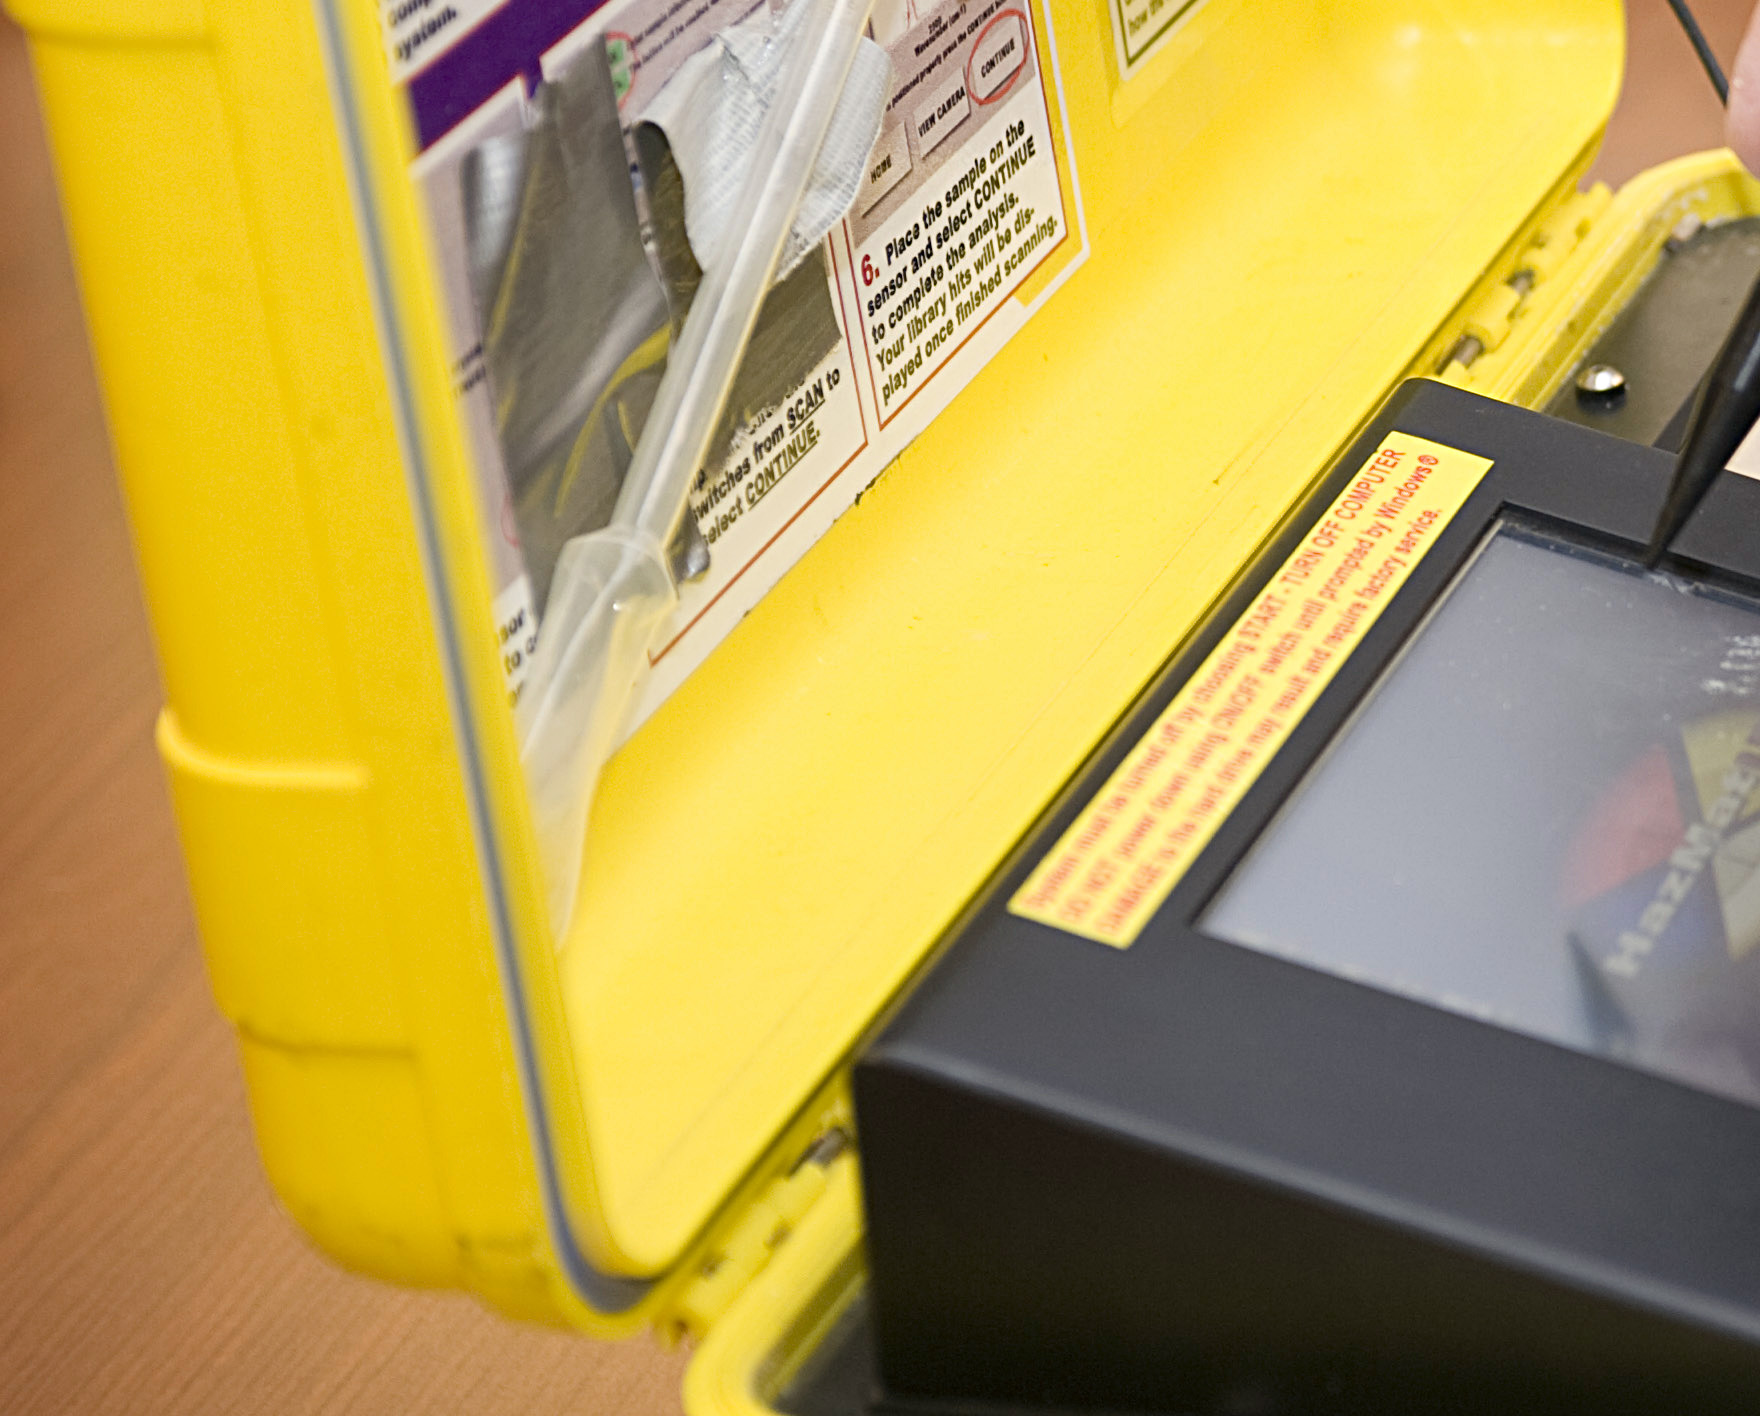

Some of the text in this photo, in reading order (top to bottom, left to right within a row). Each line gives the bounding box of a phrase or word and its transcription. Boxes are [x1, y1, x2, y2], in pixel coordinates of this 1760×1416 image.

[966, 2, 995, 35] CONTINUE
[980, 37, 1015, 78] CONTINUE
[917, 85, 966, 137] VIEW CAMERA
[860, 118, 1025, 287] 6. Place the sample on the
[869, 153, 892, 184] HOME
[866, 133, 1036, 318] sensor and select CONTINUE
[870, 191, 1020, 345] to complete the analysis.
[875, 207, 1035, 372] Your library hits will be dis-
[881, 214, 1058, 407] played once finished scanning.
[745, 419, 821, 506] CONTINUE.
[752, 422, 785, 464] from
[786, 377, 824, 430] SCAN
[825, 367, 840, 391] to
[1278, 548, 1325, 585] TURN
[1310, 518, 1344, 548] OFF
[1333, 448, 1406, 520] COMPUTER
[1353, 554, 1408, 601] factory
[1393, 508, 1442, 555] service.
[1360, 519, 1393, 539] by
